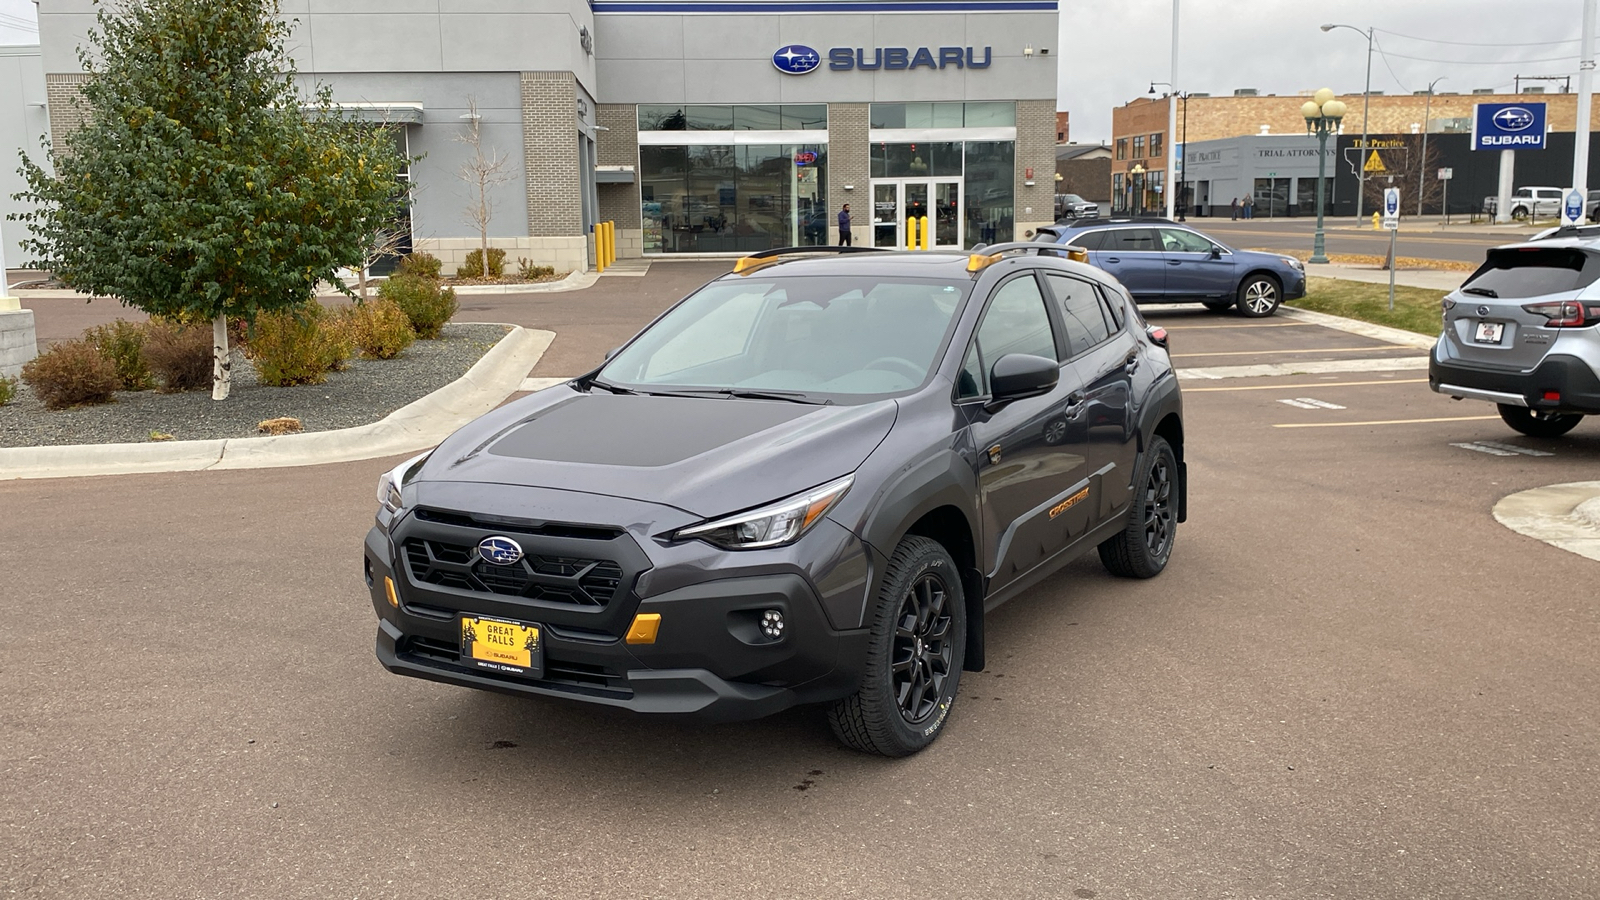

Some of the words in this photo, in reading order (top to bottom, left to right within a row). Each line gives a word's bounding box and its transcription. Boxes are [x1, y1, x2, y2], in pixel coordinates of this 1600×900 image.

[829, 46, 991, 71] SUBARU
[1371, 139, 1405, 147] Practice
[1481, 135, 1541, 145] SUBARU
[795, 153, 815, 162] OPEN
[1287, 149, 1336, 157] ATTORNYS
[1049, 487, 1089, 519] CROSSTREK
[487, 625, 514, 636] GREAT
[487, 634, 514, 646] FALLS
